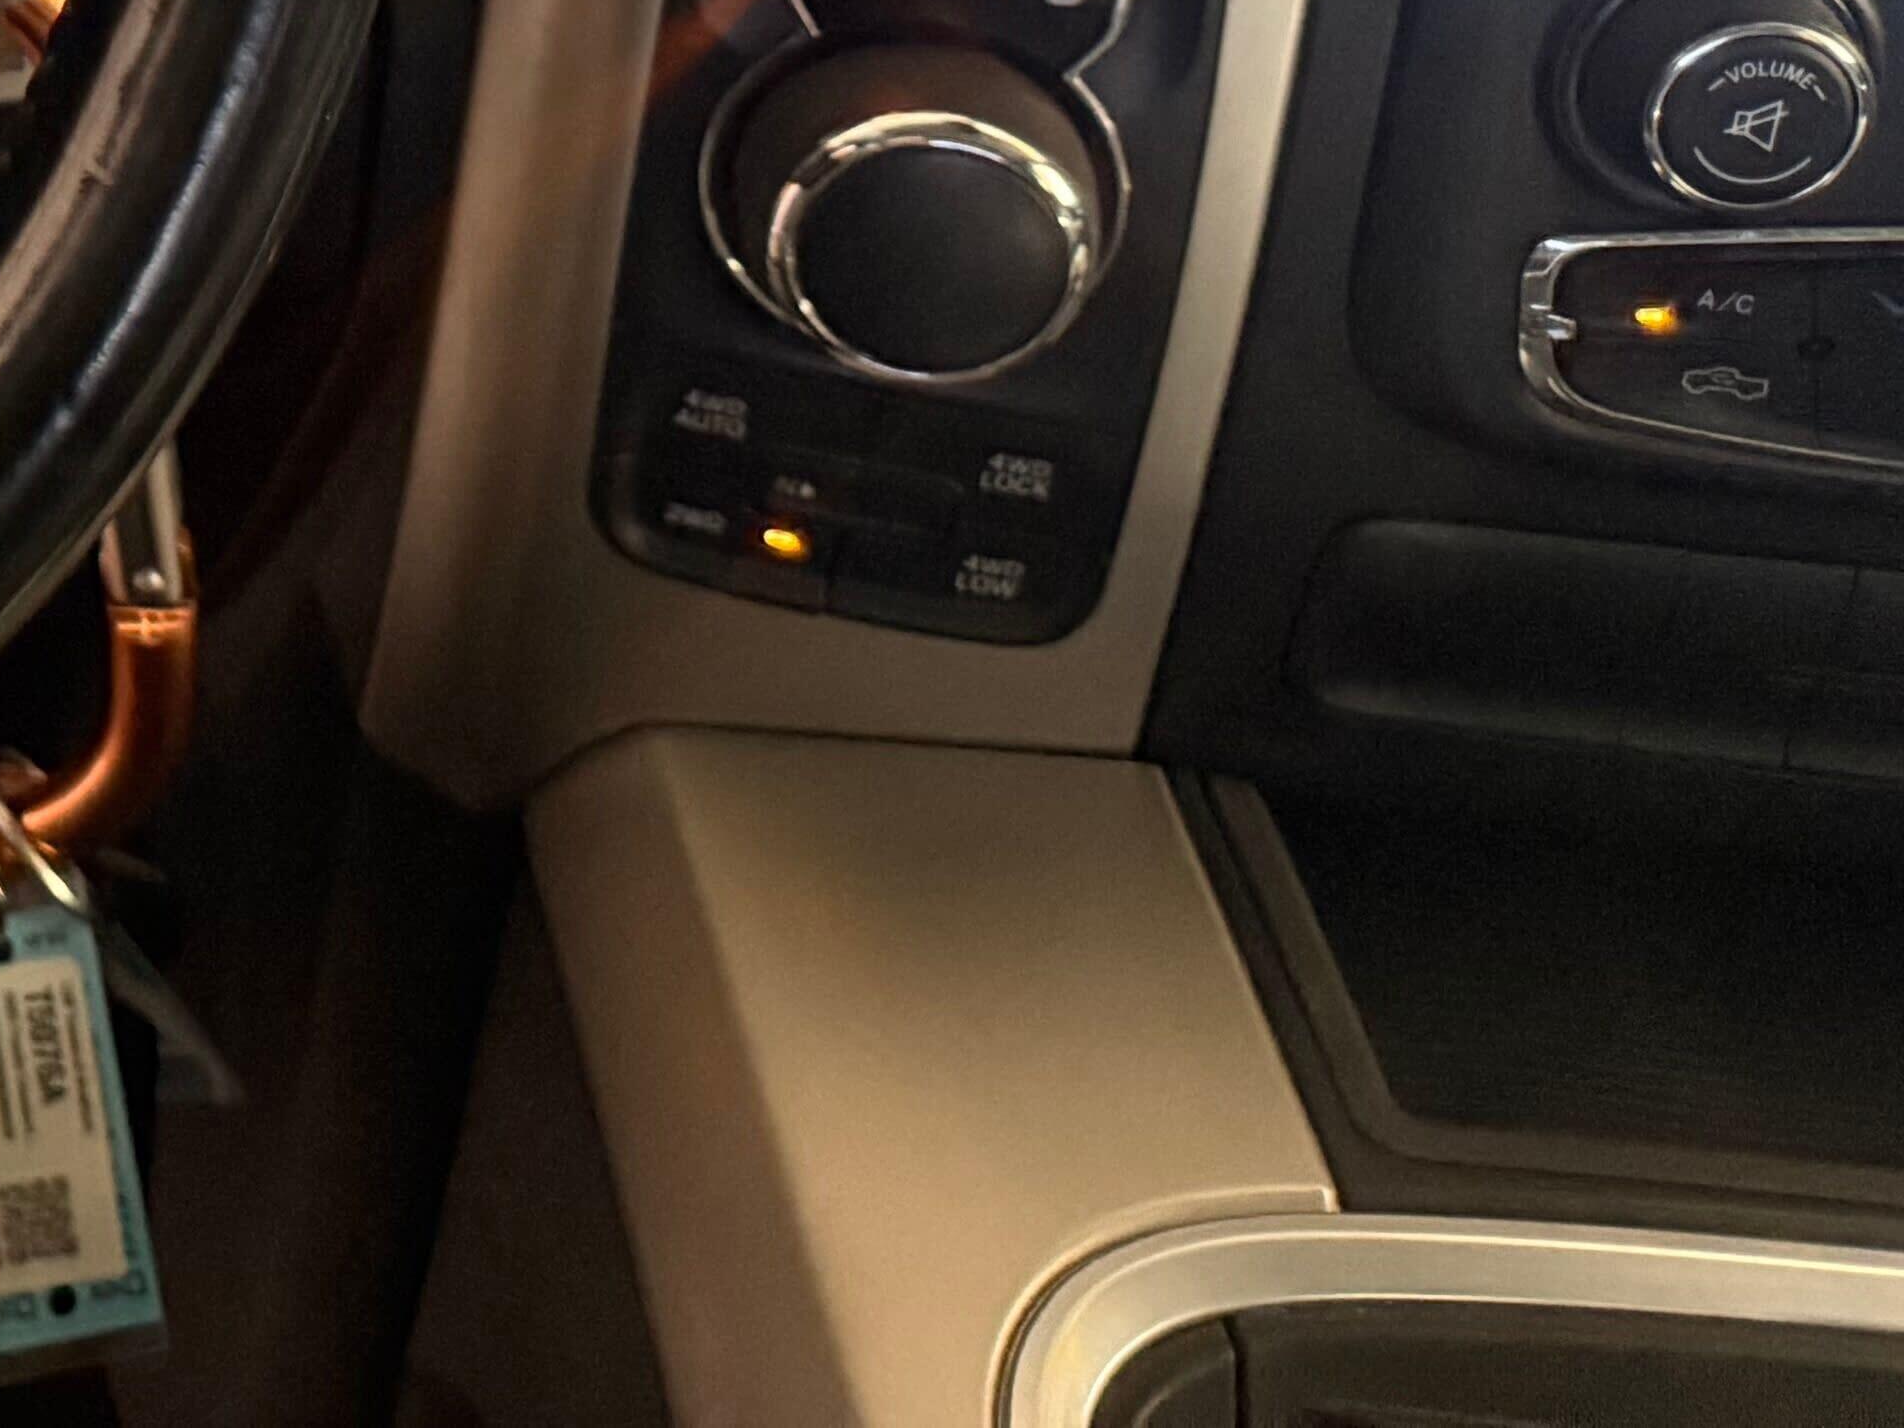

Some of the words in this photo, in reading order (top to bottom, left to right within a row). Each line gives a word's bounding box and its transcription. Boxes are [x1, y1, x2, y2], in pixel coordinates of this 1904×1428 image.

[1723, 61, 1815, 88] VOLUME
[1696, 289, 1755, 315] A/C
[987, 452, 1055, 480] 4WD
[979, 470, 1053, 503] LOCK
[960, 553, 1026, 581] 4WD
[955, 572, 1021, 601] LOW
